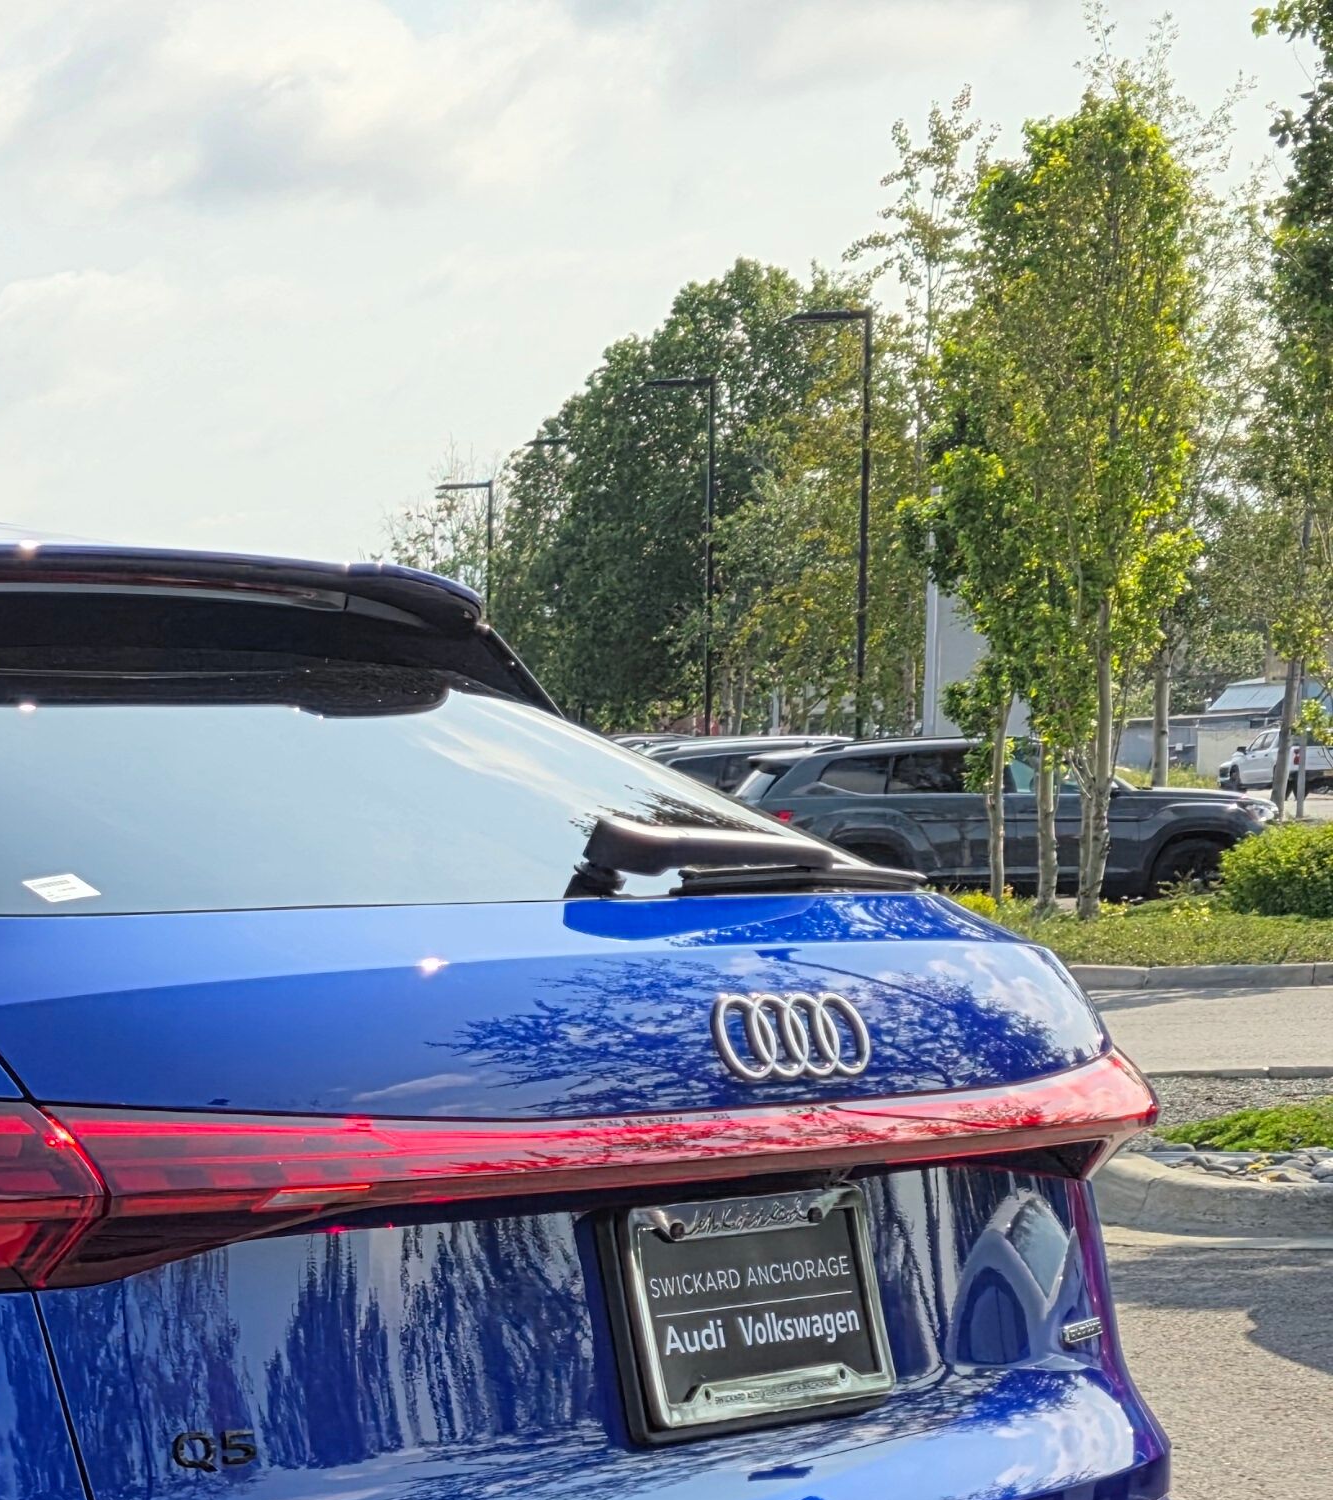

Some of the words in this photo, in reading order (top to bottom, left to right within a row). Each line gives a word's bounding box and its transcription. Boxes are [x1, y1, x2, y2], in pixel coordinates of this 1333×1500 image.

[650, 1268, 741, 1299] SWICKARD
[747, 1255, 851, 1287] ANCHORAGE
[665, 1320, 726, 1356] Audi
[738, 1308, 861, 1347] Volkswagen
[172, 1429, 257, 1473] Q5
